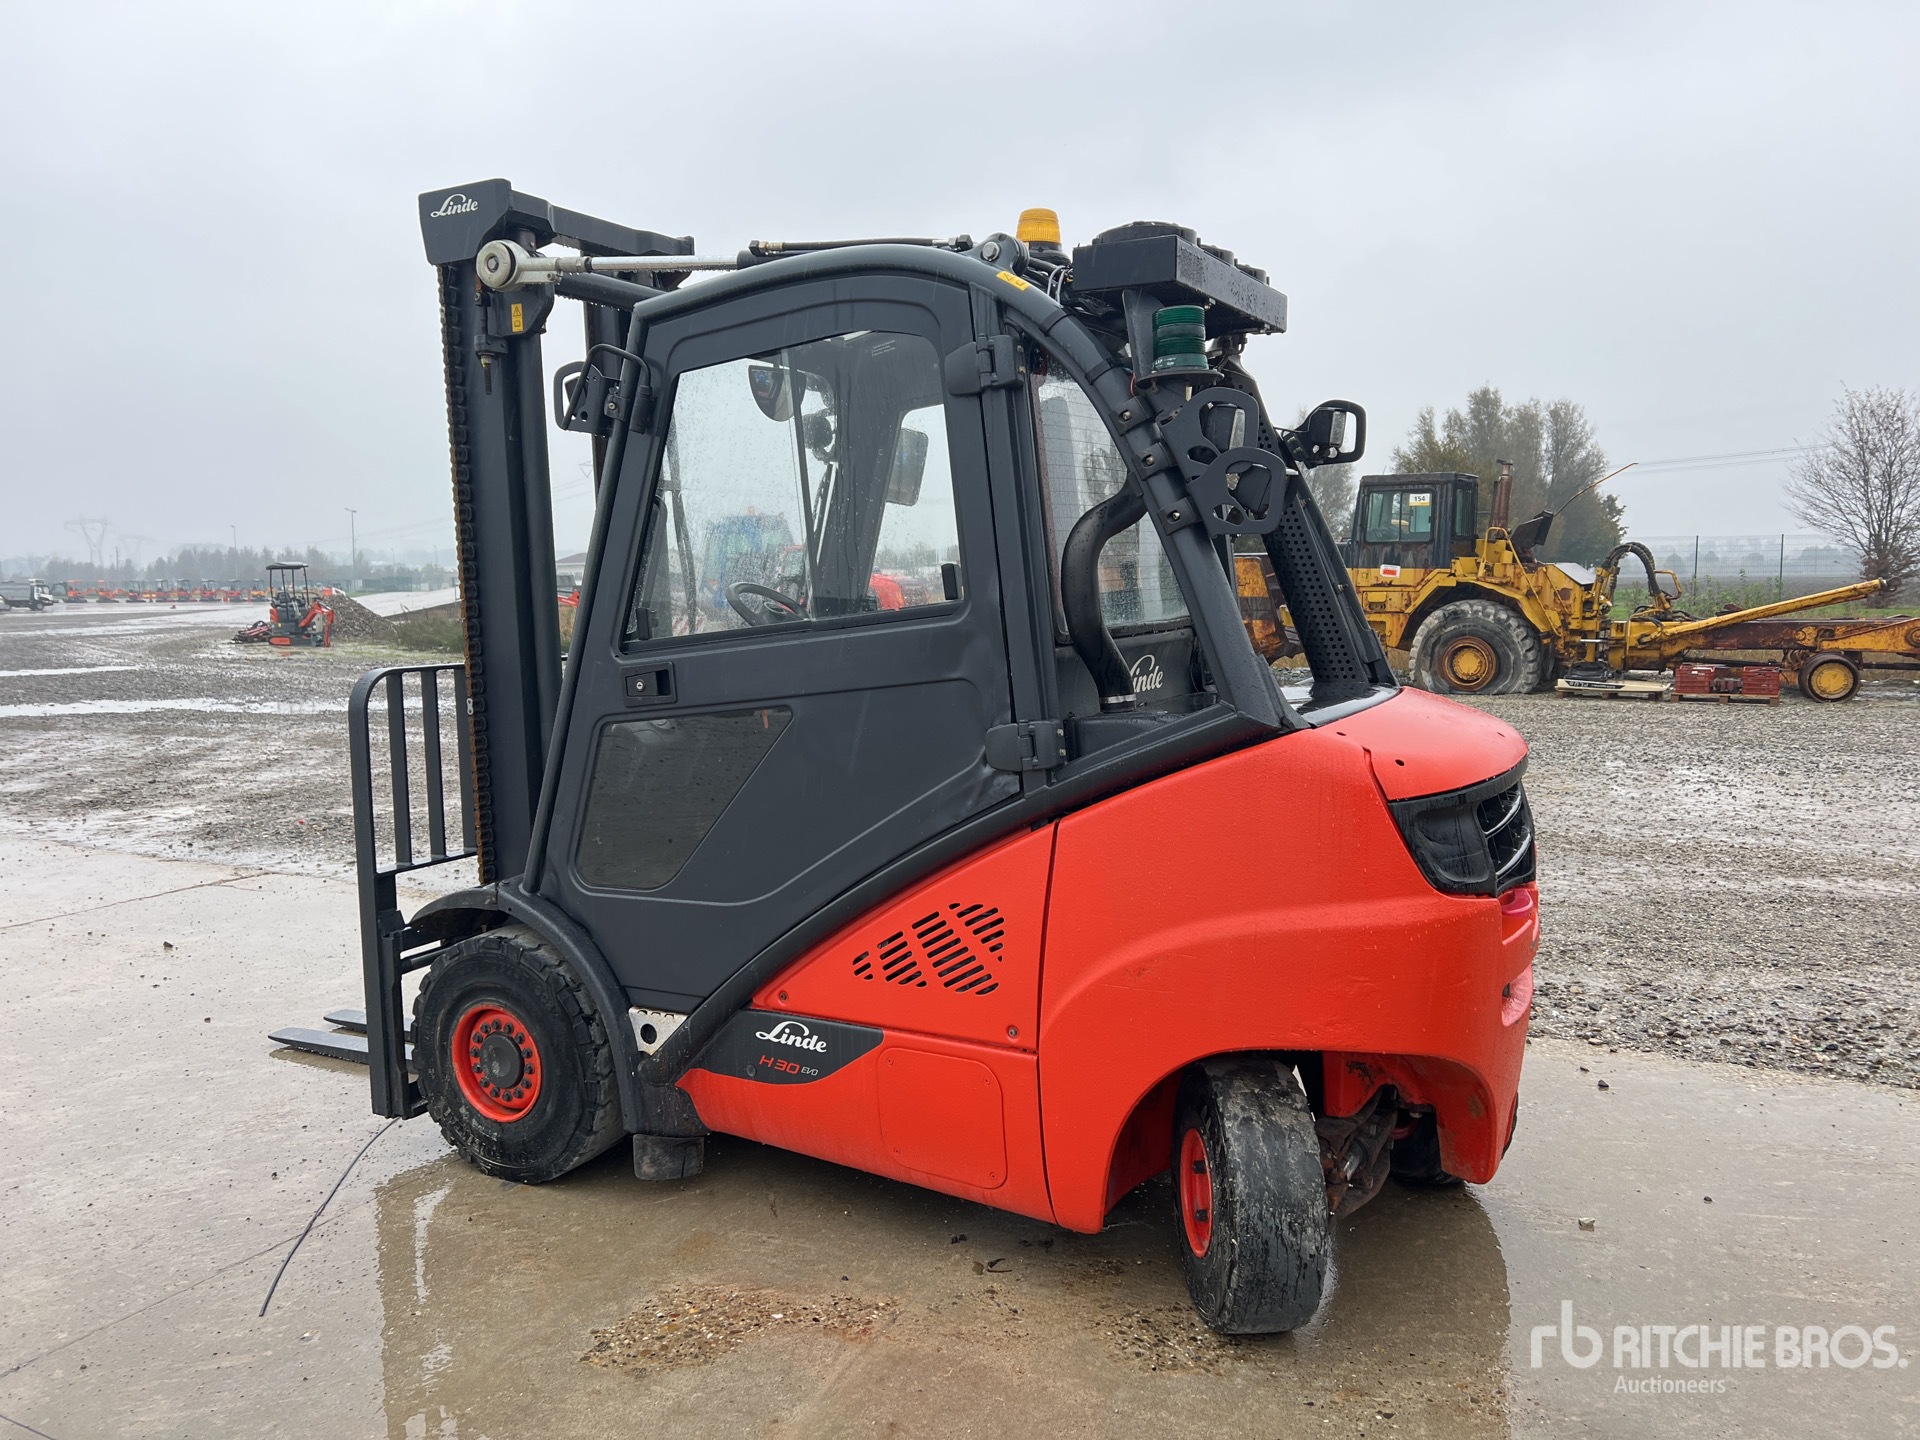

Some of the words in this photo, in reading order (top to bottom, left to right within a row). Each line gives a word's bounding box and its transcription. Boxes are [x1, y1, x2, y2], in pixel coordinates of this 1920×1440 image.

[430, 193, 478, 218] Linde
[755, 1020, 827, 1053] Linde
[801, 1066, 819, 1076] EVO
